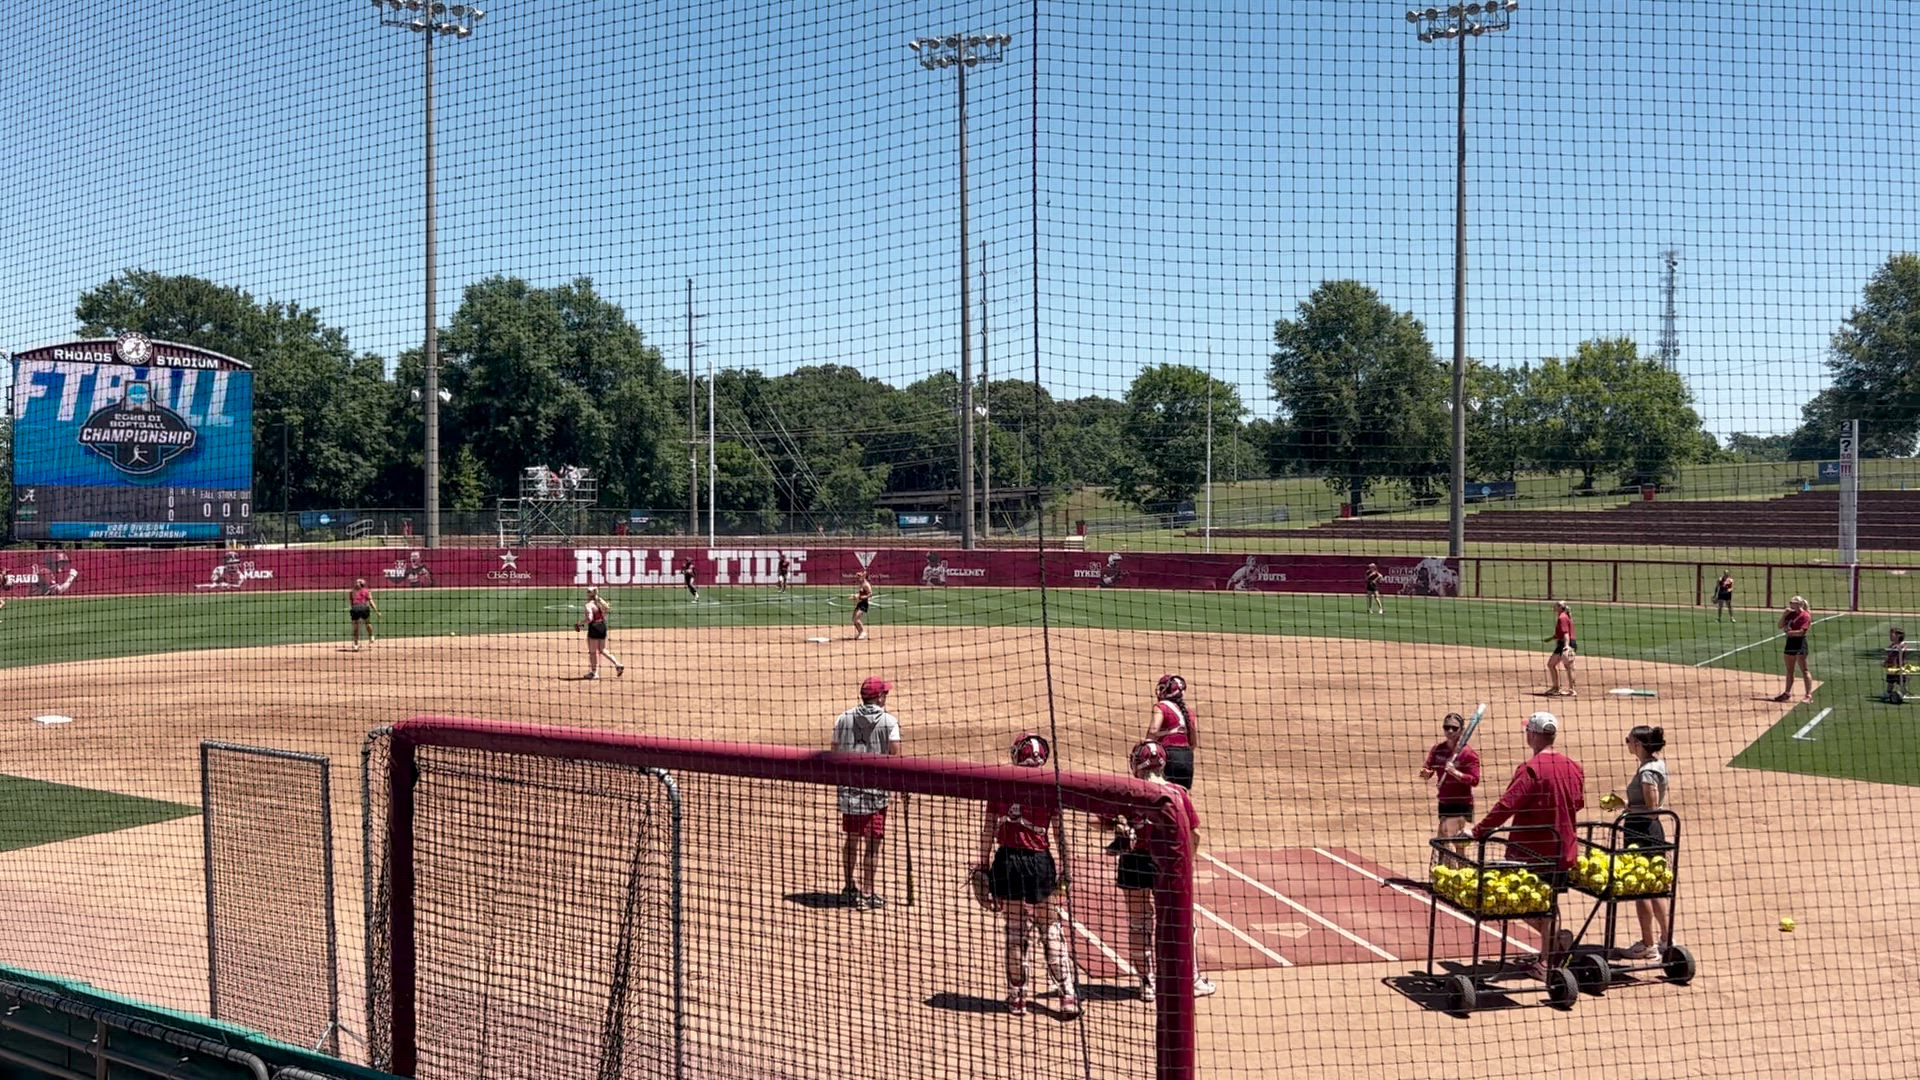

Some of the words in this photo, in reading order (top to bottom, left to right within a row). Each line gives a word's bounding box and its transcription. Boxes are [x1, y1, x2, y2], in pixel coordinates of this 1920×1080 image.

[54, 349, 112, 363] RHOADS
[156, 355, 219, 369] STADIUM
[110, 421, 166, 429] SOFTBALL
[1842, 421, 1850, 431] 2
[82, 427, 192, 444] CHAMPIONSHIP
[1841, 439, 1851, 452] ?
[203, 503, 211, 517] 0
[222, 503, 231, 517] 0
[241, 503, 249, 517] 0
[128, 530, 188, 539] CHAMPIONSHIP
[573, 550, 685, 584] ROLL
[708, 550, 807, 584] TIDE
[509, 570, 532, 579] Bank
[1073, 569, 1101, 578] DYKES
